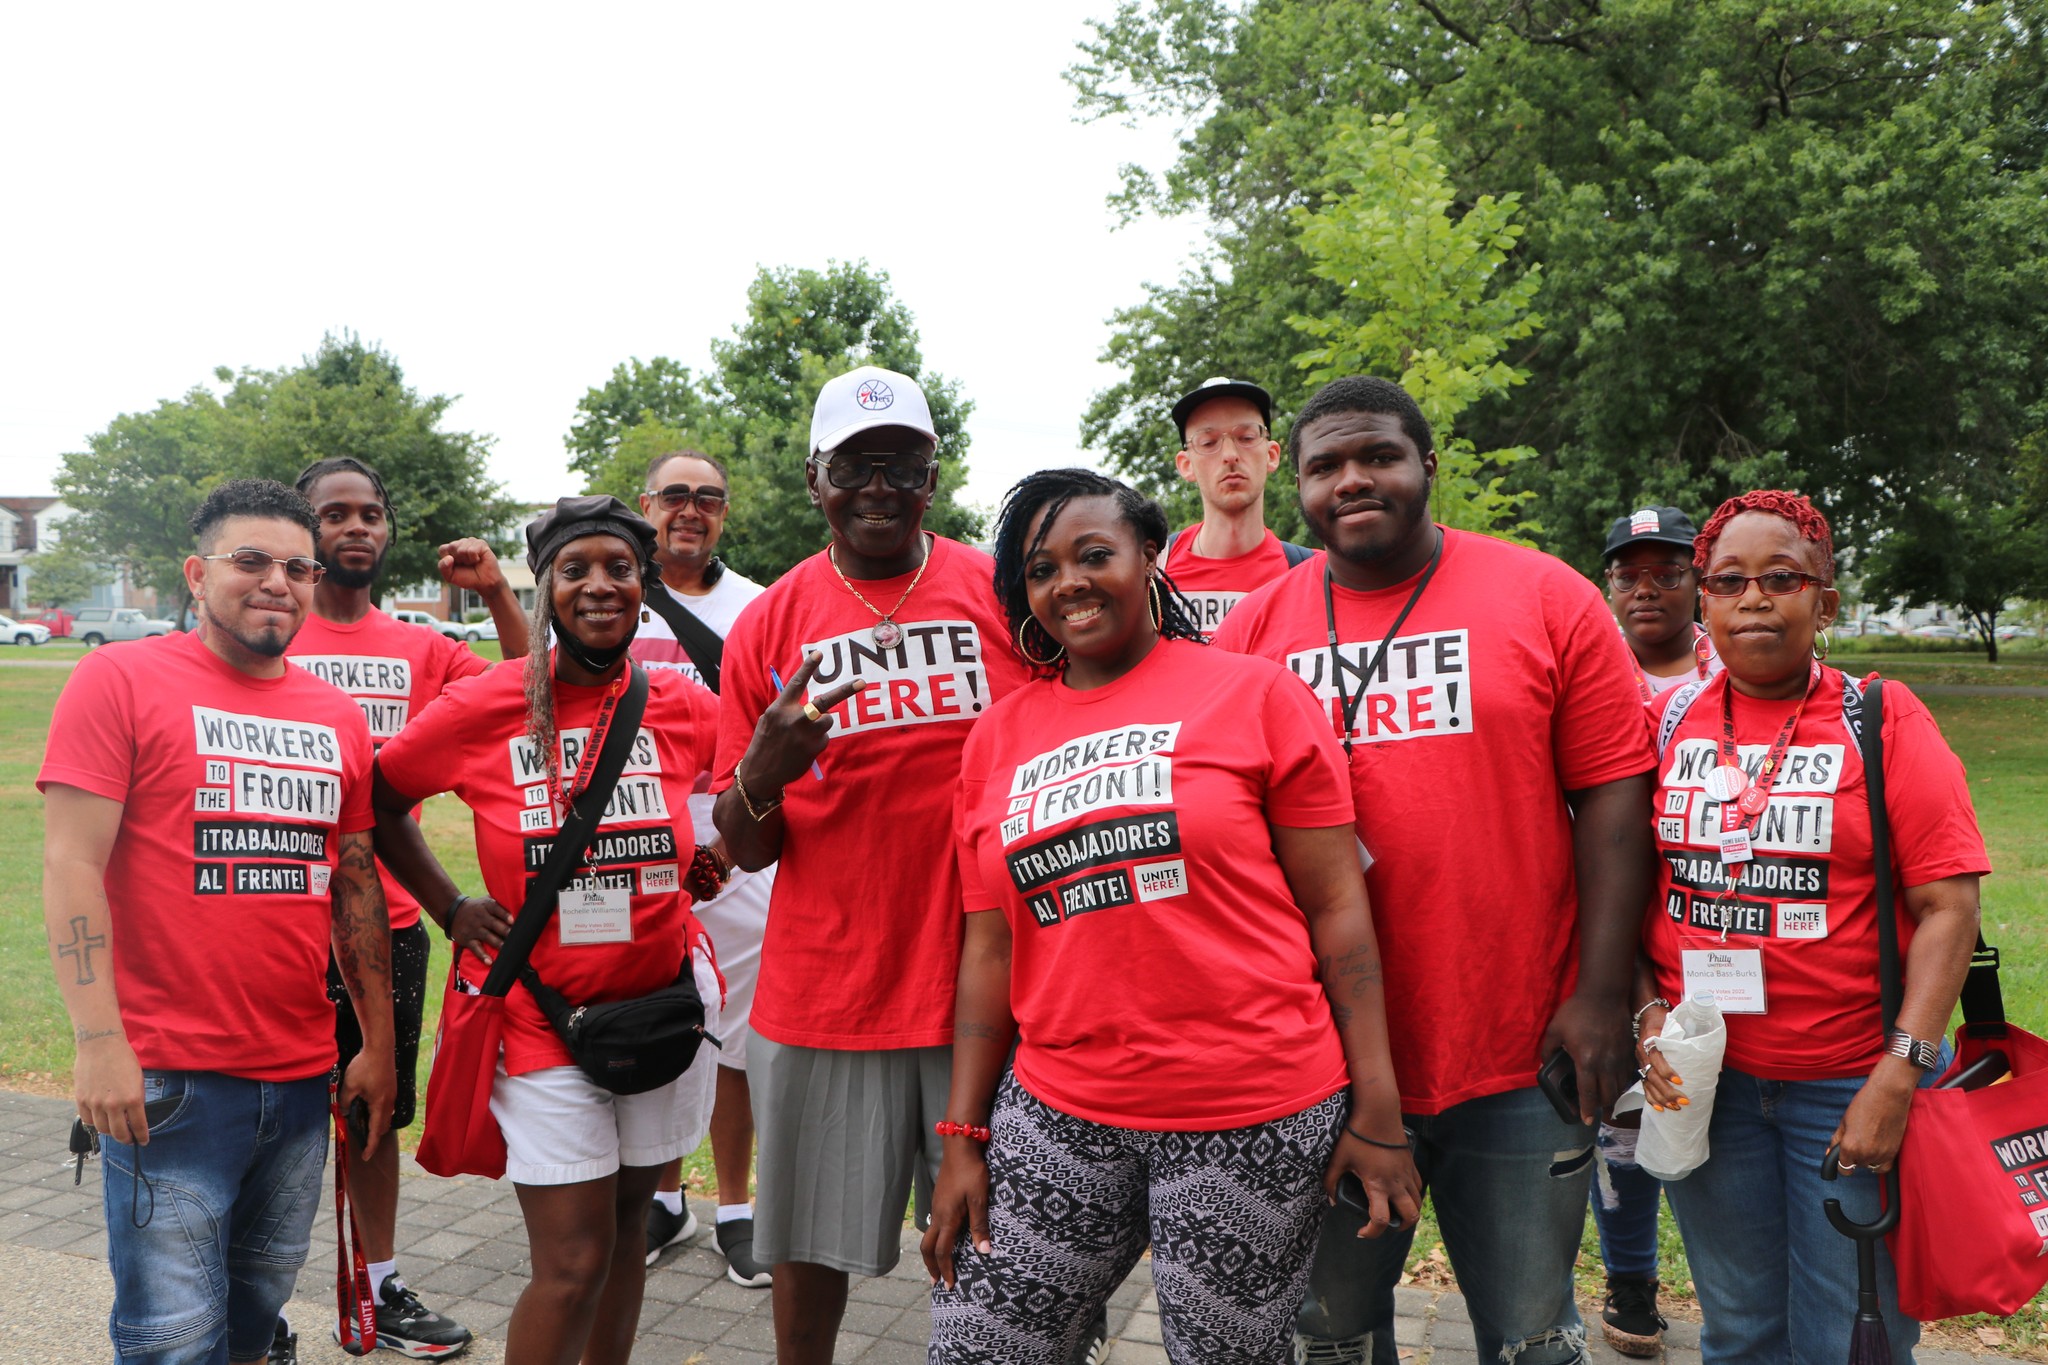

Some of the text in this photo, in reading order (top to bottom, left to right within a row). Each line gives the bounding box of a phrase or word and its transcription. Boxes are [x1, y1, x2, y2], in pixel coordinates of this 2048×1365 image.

[808, 626, 977, 684] UNITE
[1291, 635, 1463, 689] UNITE
[603, 696, 615, 710] ONE
[1322, 681, 1460, 738] ERE!
[201, 714, 335, 763] WORKERS
[587, 728, 605, 759] SHOULD
[1723, 740, 1734, 756] ONE
[1020, 730, 1170, 792] WORKERS
[1678, 746, 1832, 785] WOKRS
[210, 764, 226, 781] TO
[243, 771, 336, 816] FRONT!
[528, 788, 545, 803] TO
[1043, 761, 1161, 820] FRONT!
[199, 791, 226, 809] THE
[1014, 798, 1029, 811] TO
[1669, 794, 1684, 811] TO
[523, 811, 549, 827] THE
[1700, 801, 1822, 845] FNT!
[1003, 816, 1025, 841] THE
[1660, 821, 1680, 839] THE
[531, 833, 672, 866] ¡TJADORES
[199, 868, 305, 890] AL FRENTE!
[313, 872, 329, 882] UNITE
[645, 870, 675, 881] UNITE
[646, 878, 674, 888] HERE!
[1141, 868, 1179, 883] UNITE
[1668, 858, 1820, 892] TRABAADORES
[1143, 878, 1180, 893] HERE!
[1033, 875, 1128, 923] AL FRENTE!
[1668, 895, 1764, 931] AL FRENTE!
[1784, 912, 1820, 921] UNITE
[1784, 921, 1819, 930] HERE!
[1707, 952, 1732, 963] Philly
[1717, 969, 1757, 977] Bass-Burks
[2014, 1174, 2029, 1187] TO
[2020, 1190, 2040, 1206] THE
